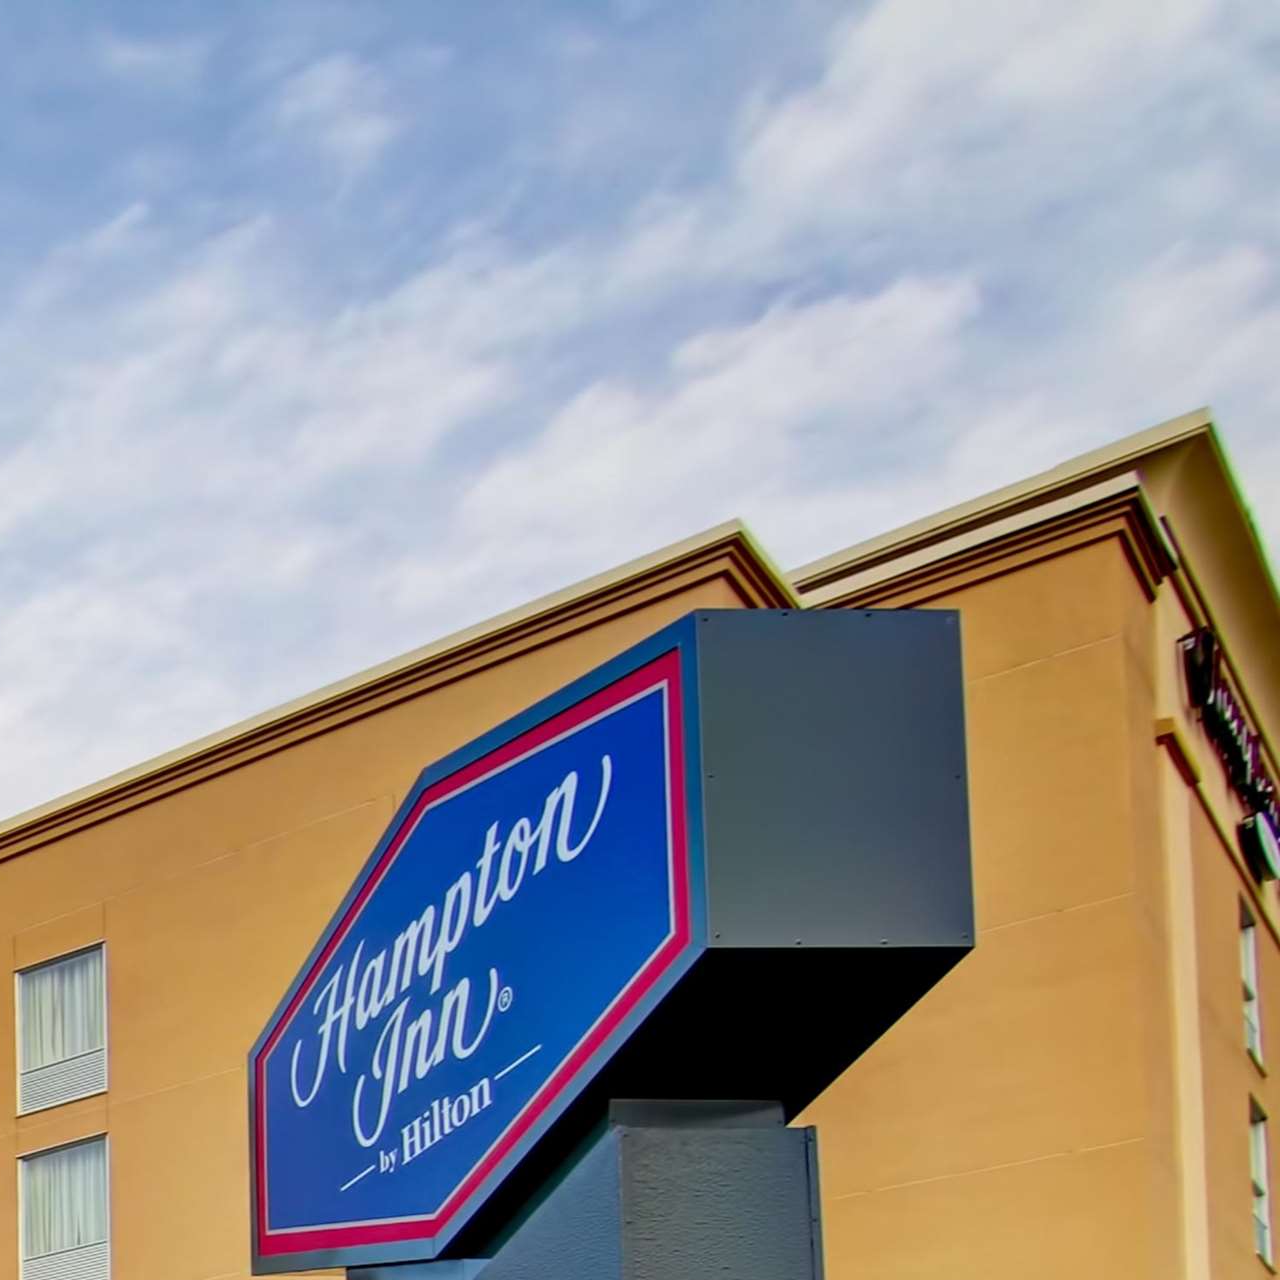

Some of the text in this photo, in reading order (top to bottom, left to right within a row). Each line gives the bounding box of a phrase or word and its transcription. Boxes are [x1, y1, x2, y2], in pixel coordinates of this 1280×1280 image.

[290, 755, 613, 1107] Hampton
[378, 1077, 492, 1173] by Hilton
